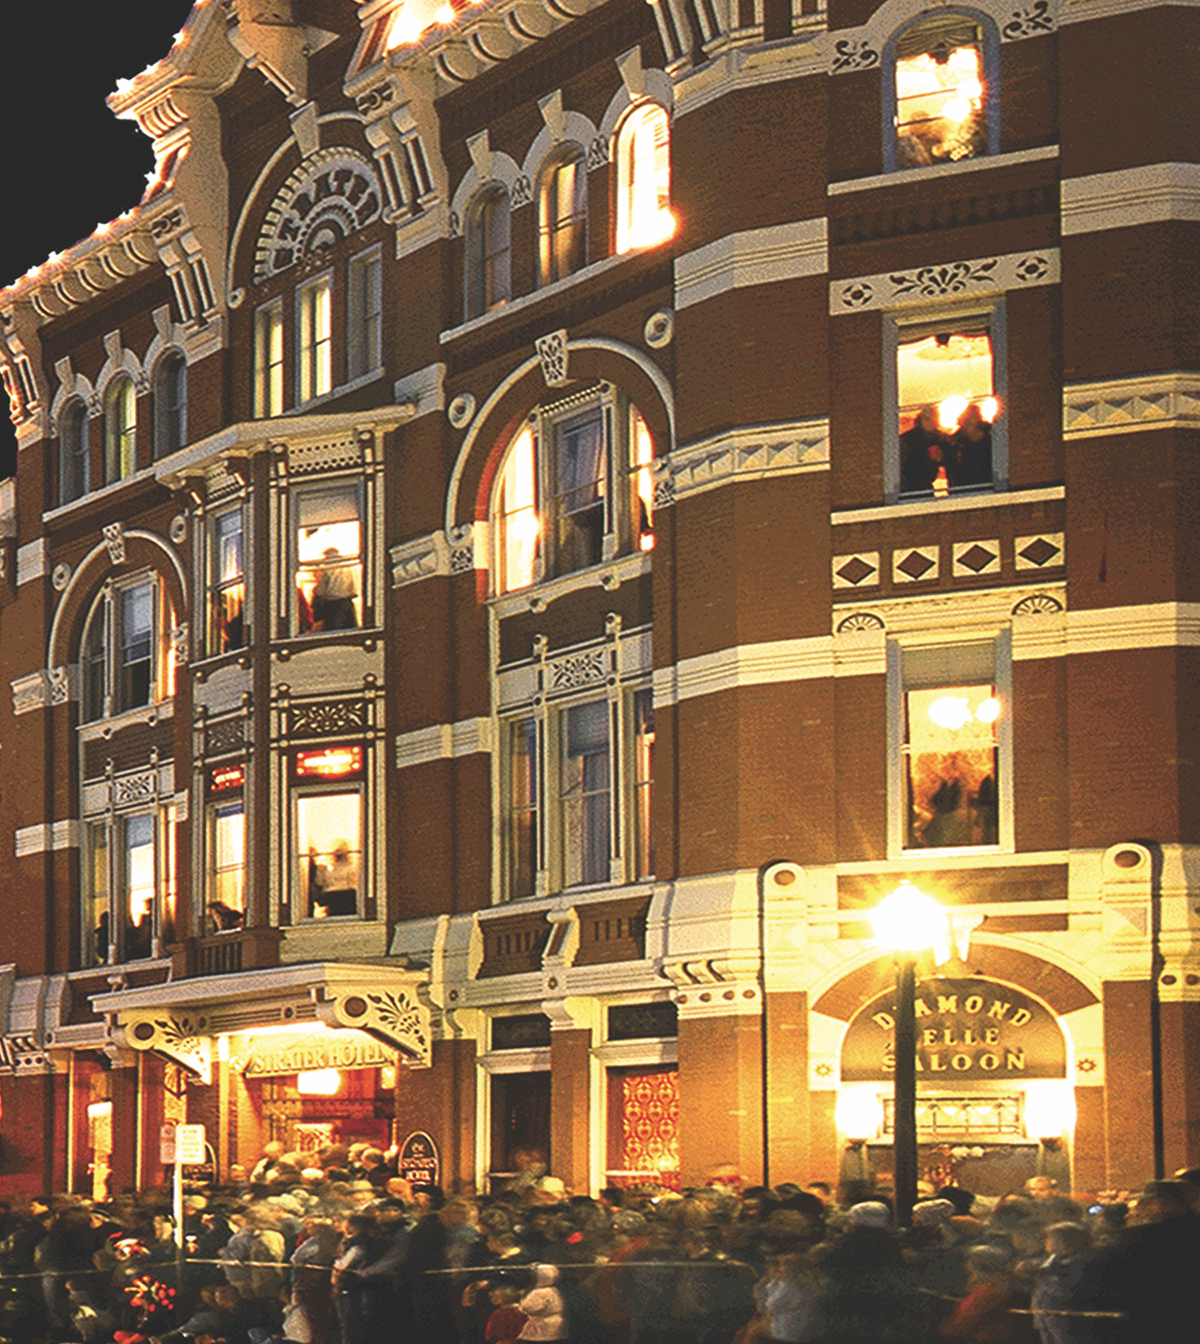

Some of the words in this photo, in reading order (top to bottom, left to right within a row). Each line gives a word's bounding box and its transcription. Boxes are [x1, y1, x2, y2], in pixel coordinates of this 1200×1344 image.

[273, 168, 380, 270] STRATER
[871, 995, 1032, 1030] DAMOND
[923, 1027, 1000, 1046] ELLE
[254, 1047, 324, 1073] STRATER
[328, 1043, 385, 1067] HOTEL
